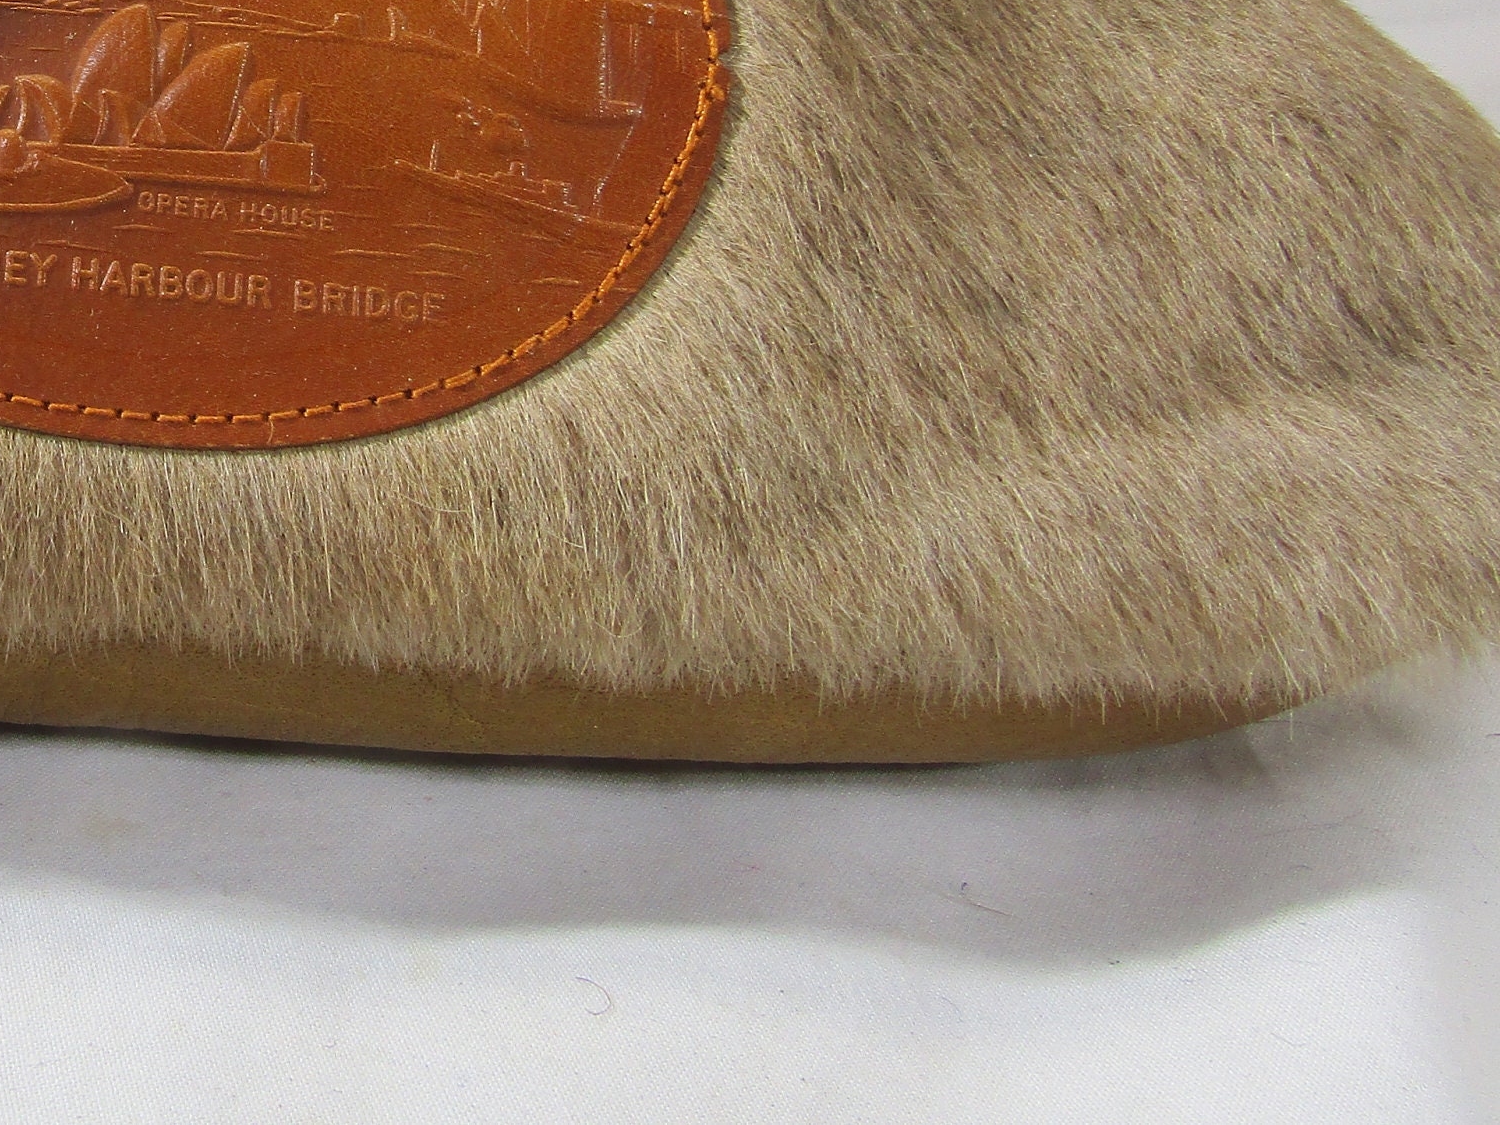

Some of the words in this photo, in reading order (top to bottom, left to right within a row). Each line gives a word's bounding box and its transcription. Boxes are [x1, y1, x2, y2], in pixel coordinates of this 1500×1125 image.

[137, 189, 228, 222] OPERA
[240, 202, 335, 232] HOUSE
[71, 256, 271, 311] HARBOUR
[294, 279, 446, 322] BRIDGE
